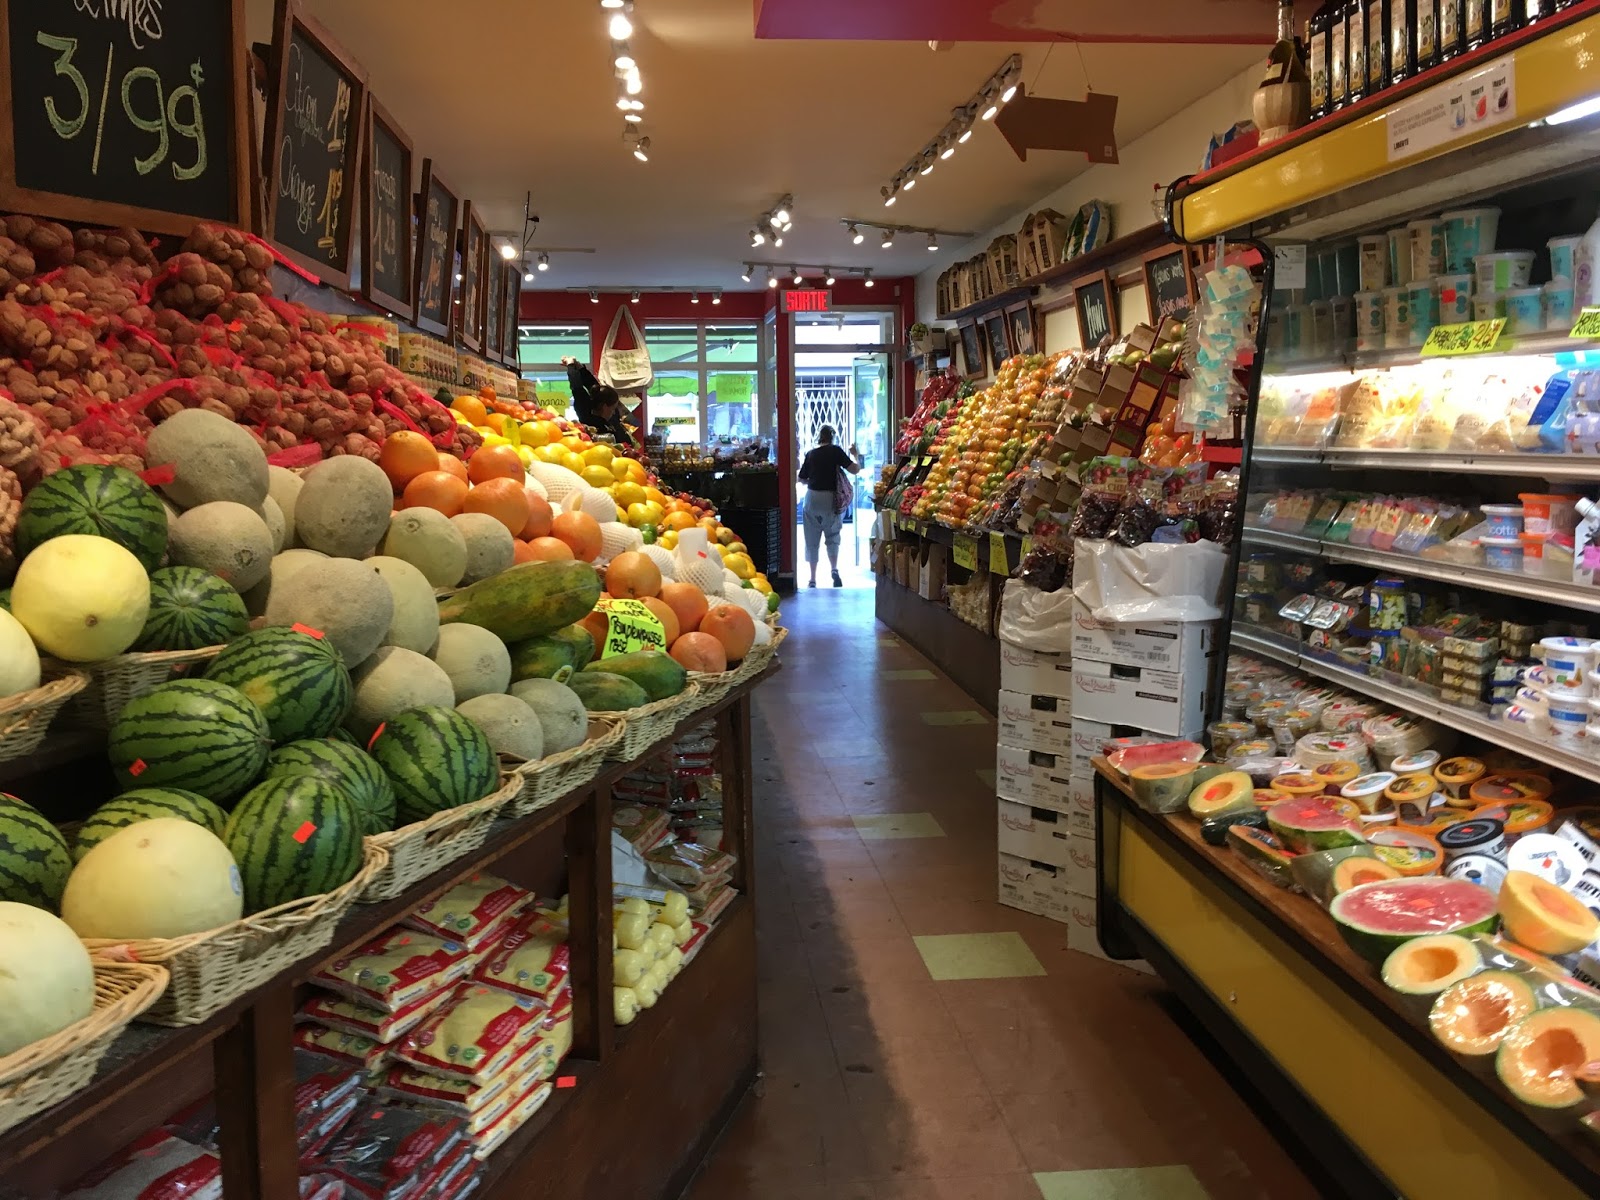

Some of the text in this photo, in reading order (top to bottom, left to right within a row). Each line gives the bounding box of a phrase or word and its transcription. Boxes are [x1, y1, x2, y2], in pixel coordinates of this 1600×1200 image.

[786, 291, 829, 311] SORTIE
[1488, 525, 1518, 536] cotta
[503, 930, 526, 949] Clic
